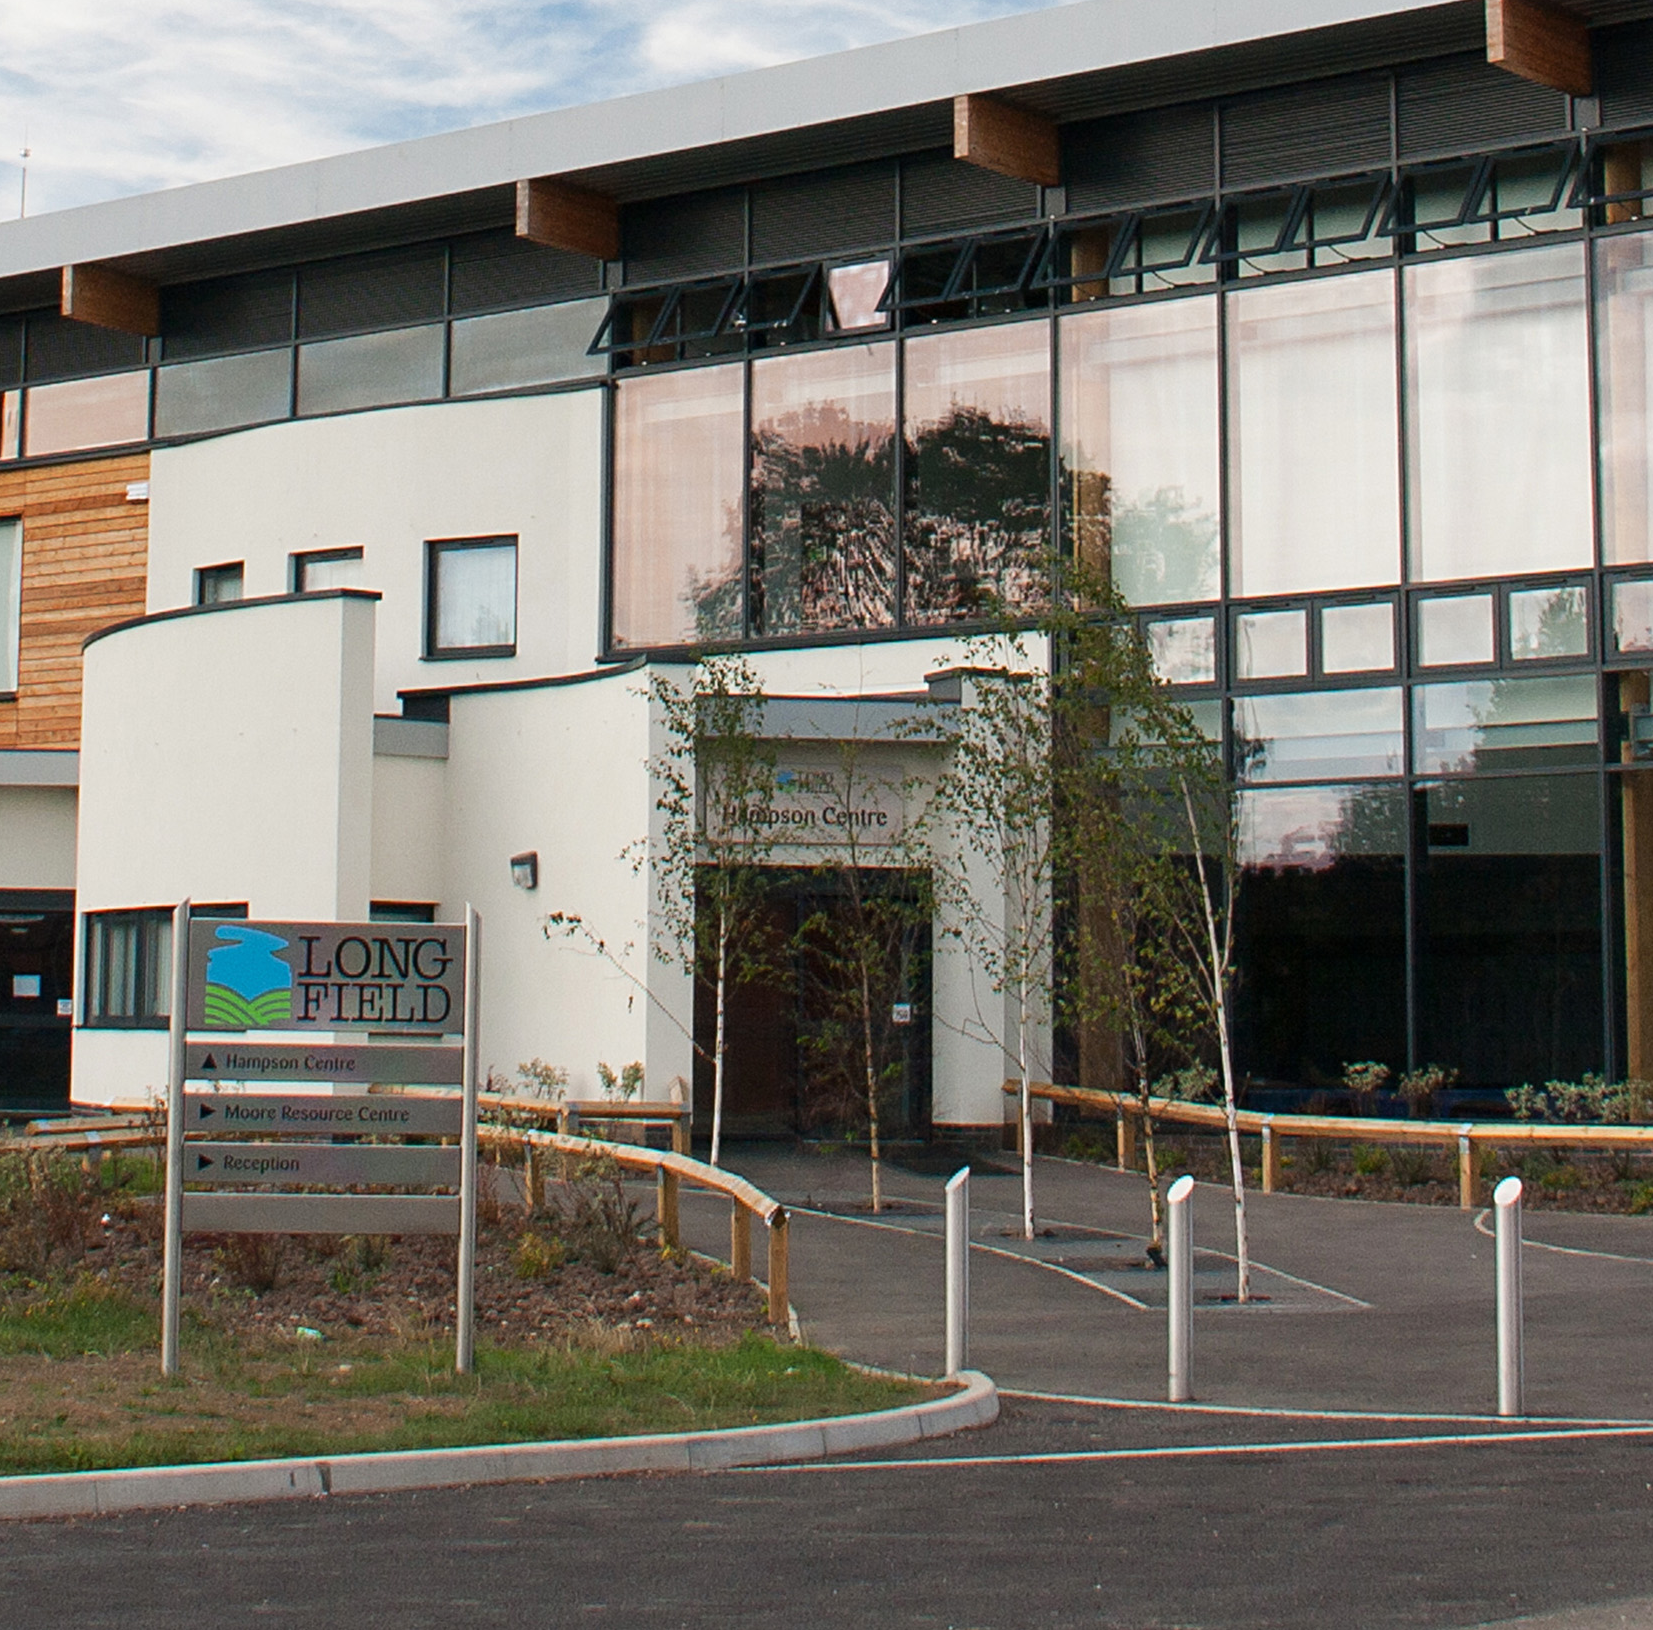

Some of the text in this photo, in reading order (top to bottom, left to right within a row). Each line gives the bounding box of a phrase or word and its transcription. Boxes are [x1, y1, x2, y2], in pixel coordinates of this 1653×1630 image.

[722, 804, 888, 828] Hmpson Centre
[297, 935, 453, 980] LONG
[297, 982, 452, 1024] FIELD
[225, 1052, 356, 1072] Hampson Centre
[224, 1103, 410, 1122] Moore Resource Centre
[222, 1154, 300, 1174] Reception
